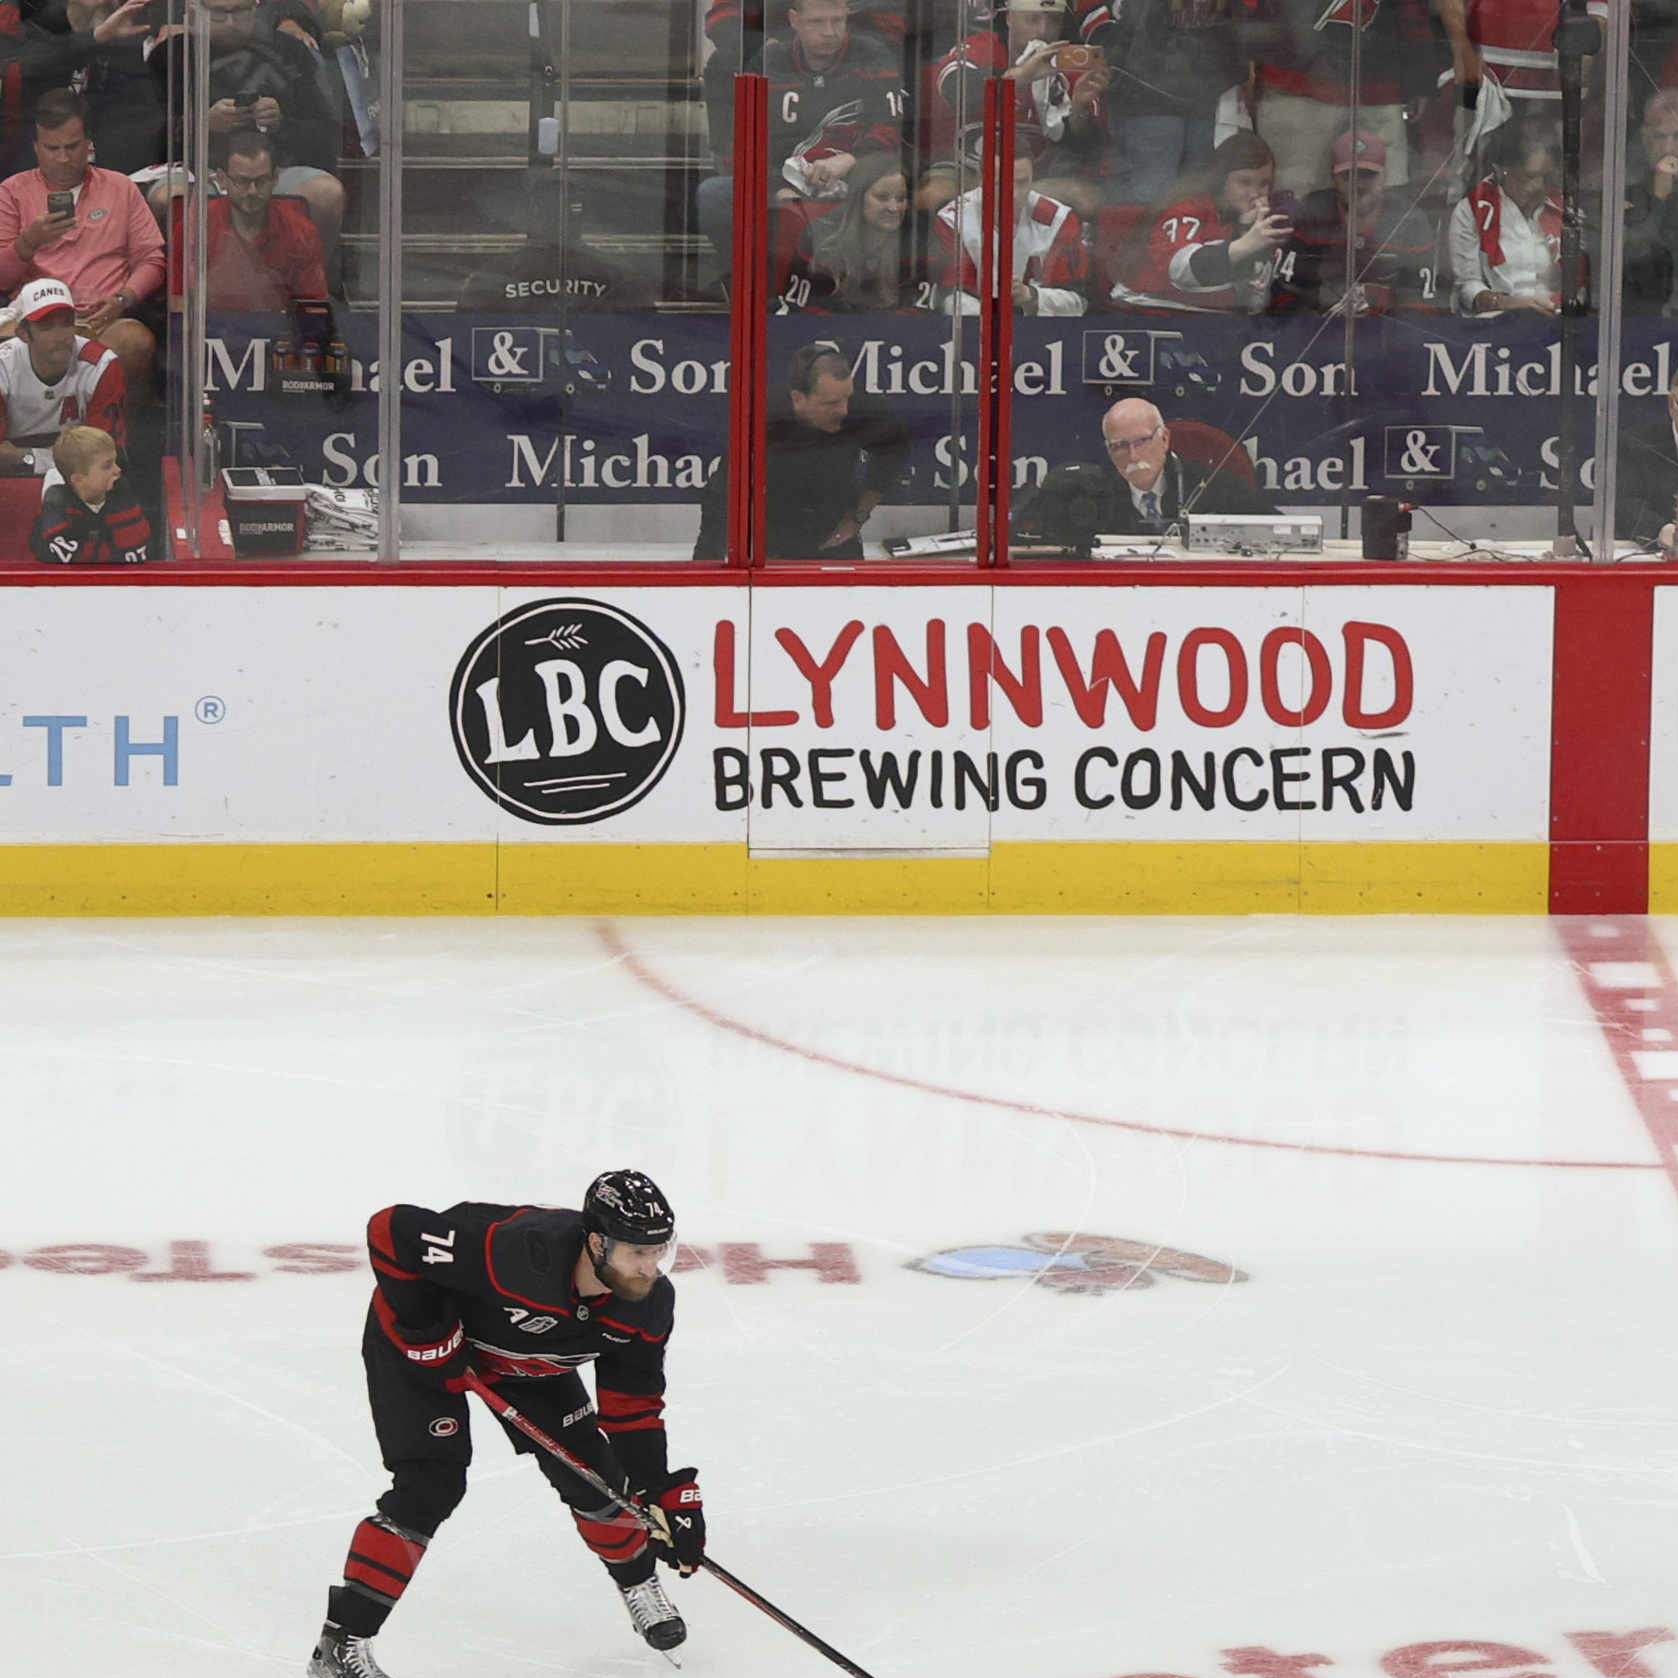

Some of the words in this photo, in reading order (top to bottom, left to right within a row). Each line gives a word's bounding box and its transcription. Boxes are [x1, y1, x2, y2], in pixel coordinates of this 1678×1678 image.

[782, 91, 799, 124] C
[33, 286, 66, 303] CANES
[502, 279, 603, 300] SECURITY
[203, 337, 457, 394] Mael
[486, 331, 528, 376] &
[814, 339, 1067, 396] Michel
[1098, 333, 1140, 378] &
[1239, 341, 1359, 397] Son
[506, 432, 722, 488] Micha
[933, 434, 1048, 490] Sn
[1400, 429, 1441, 473] &
[238, 522, 294, 533] BODYARMOR
[715, 618, 1413, 732] LYNNWOOD
[471, 657, 667, 767] LBC
[713, 746, 1047, 813] BREWING
[1074, 746, 1415, 814] CONCERN
[646, 1201, 664, 1218] 74
[421, 1229, 455, 1265] 74
[503, 1307, 530, 1324] A
